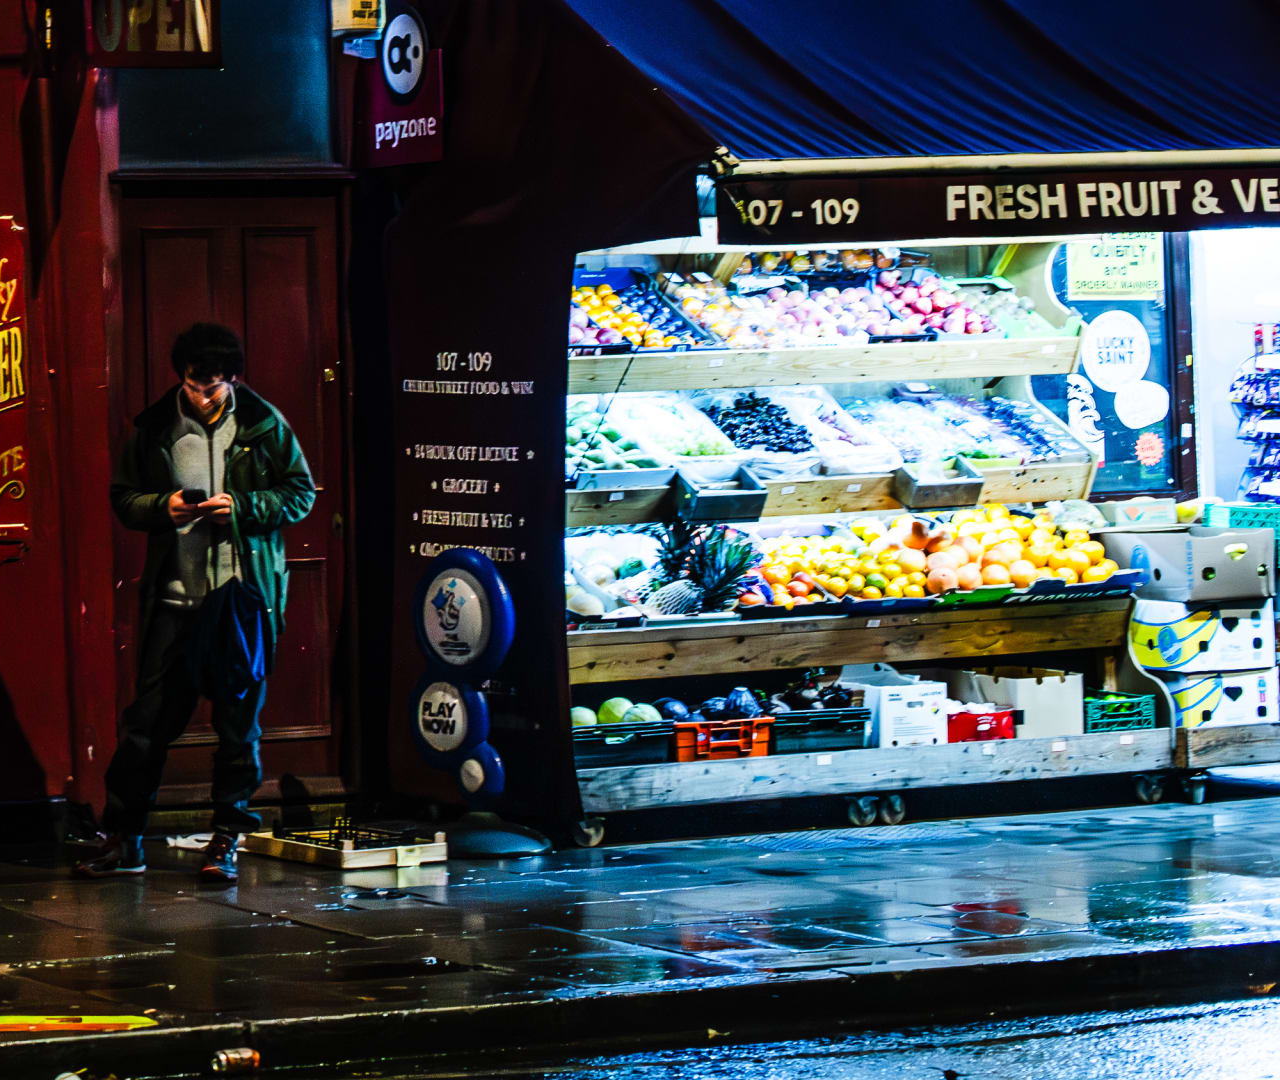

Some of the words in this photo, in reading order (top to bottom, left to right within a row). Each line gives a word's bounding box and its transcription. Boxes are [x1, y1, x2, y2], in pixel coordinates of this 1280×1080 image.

[375, 116, 437, 150] payzone
[740, 199, 783, 225] 07
[811, 199, 860, 225] 109
[946, 182, 1067, 221] FRESH
[1077, 180, 1181, 218] FRUIT
[1192, 179, 1224, 215] &
[1232, 178, 1280, 214] VE
[1104, 264, 1127, 277] and
[1096, 336, 1136, 349] LUCKY
[436, 353, 457, 371] 107
[468, 352, 492, 372] 109
[1097, 351, 1136, 364] SAINT
[470, 381, 500, 396] FOOD
[457, 446, 477, 461] OFF
[489, 513, 513, 528] VEG
[423, 701, 457, 720] PLAY
